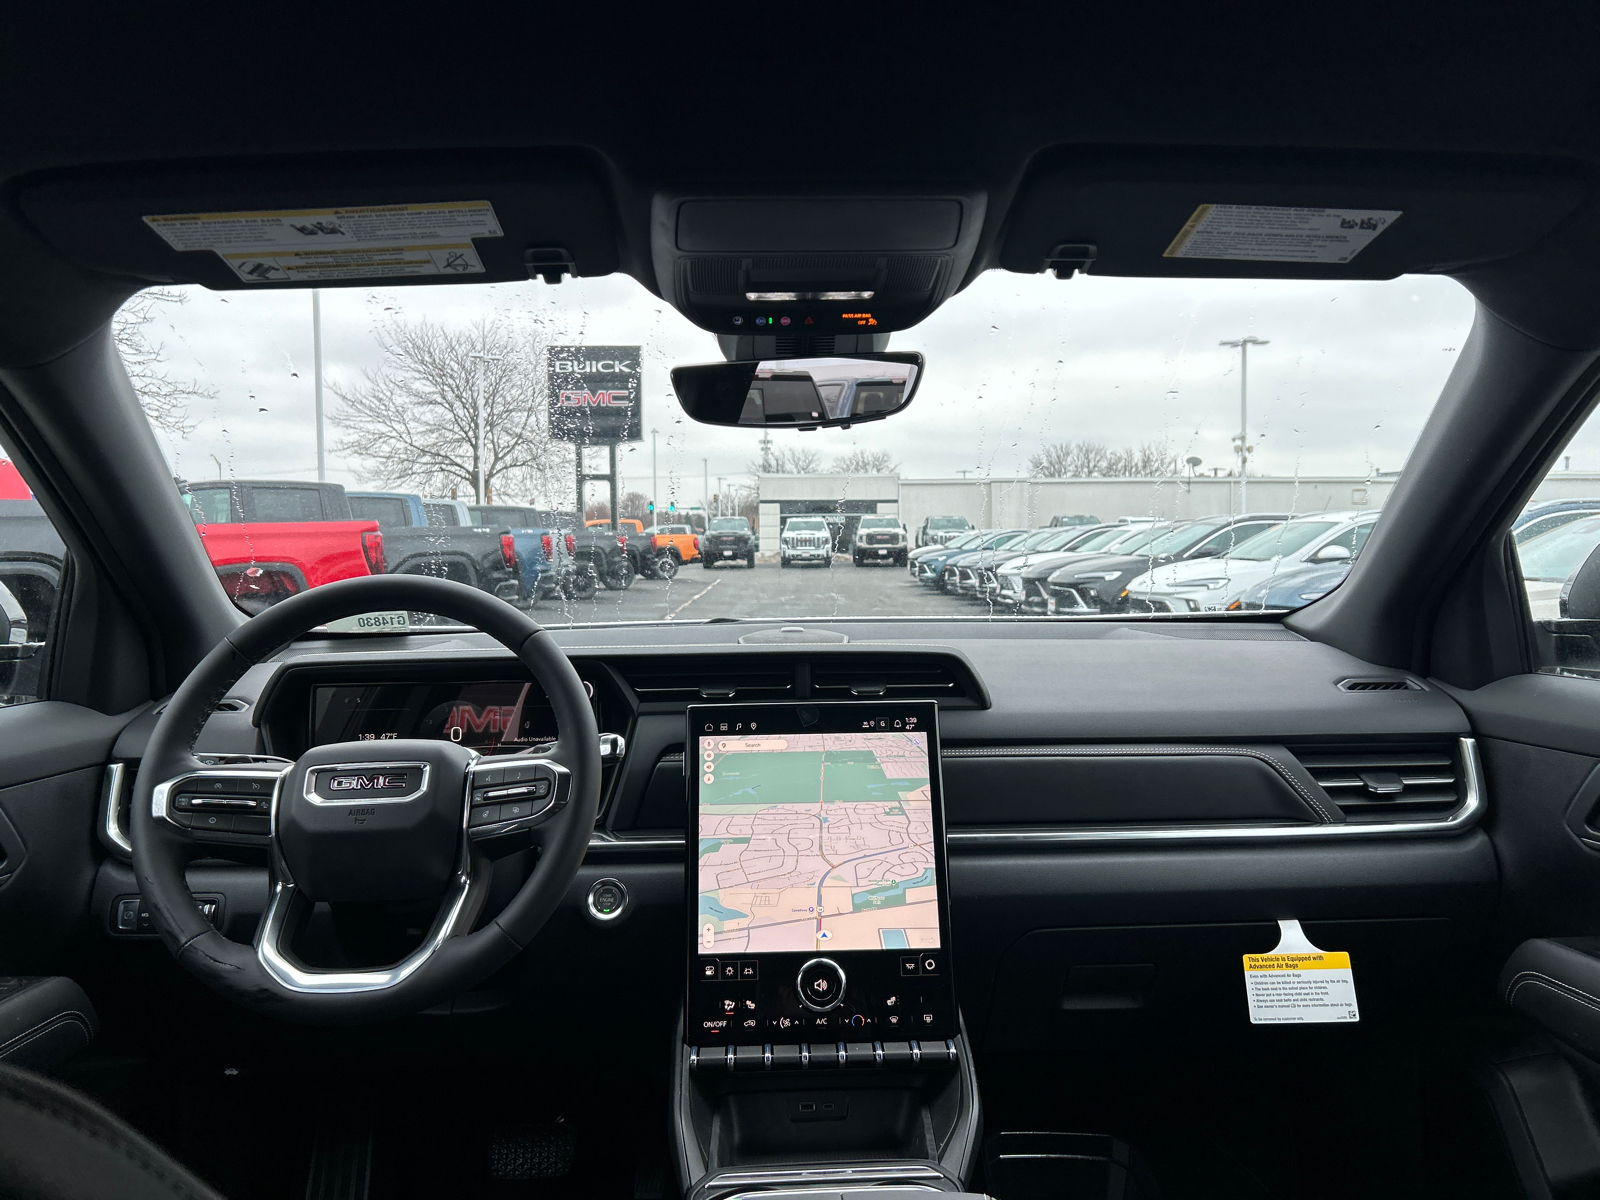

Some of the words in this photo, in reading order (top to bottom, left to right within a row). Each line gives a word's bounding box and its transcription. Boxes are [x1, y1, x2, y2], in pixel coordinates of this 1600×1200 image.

[555, 361, 632, 373] BUICK
[560, 390, 629, 406] GMC
[451, 726, 462, 742] 0
[330, 773, 407, 790] GMC
[348, 809, 376, 817] AIRBAG
